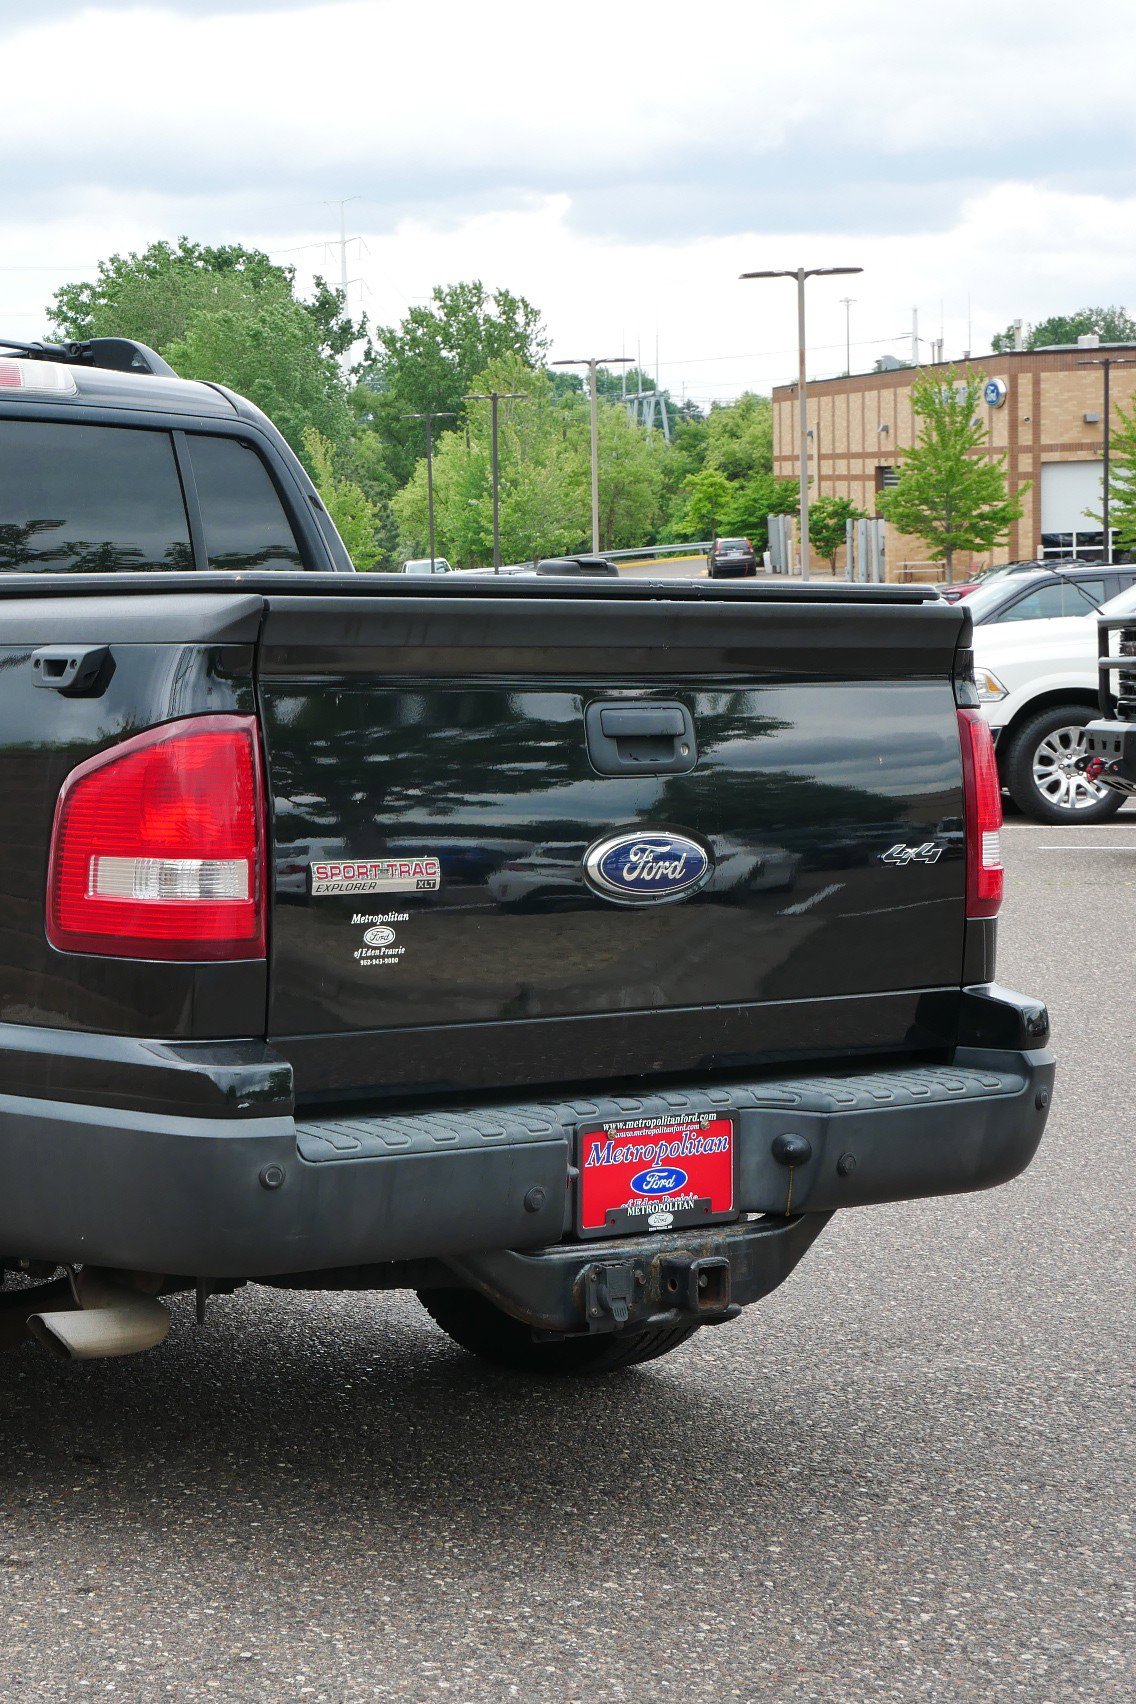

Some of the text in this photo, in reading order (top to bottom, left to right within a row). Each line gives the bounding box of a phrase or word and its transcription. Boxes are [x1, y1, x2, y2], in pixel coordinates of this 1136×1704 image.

[315, 860, 438, 881] SPORT TRAC
[622, 843, 687, 882] Ford
[315, 881, 378, 893] EXPLORER
[416, 879, 437, 889] XLT
[350, 910, 410, 925] Metropolitan
[369, 930, 391, 942] Ford
[353, 945, 406, 960] of Eden Prairie
[602, 1112, 717, 1131] www.metropolitanford.com
[585, 1131, 730, 1168] Metropolitan
[642, 1171, 676, 1190] Ford
[627, 1199, 695, 1217] METROPOLITAN
